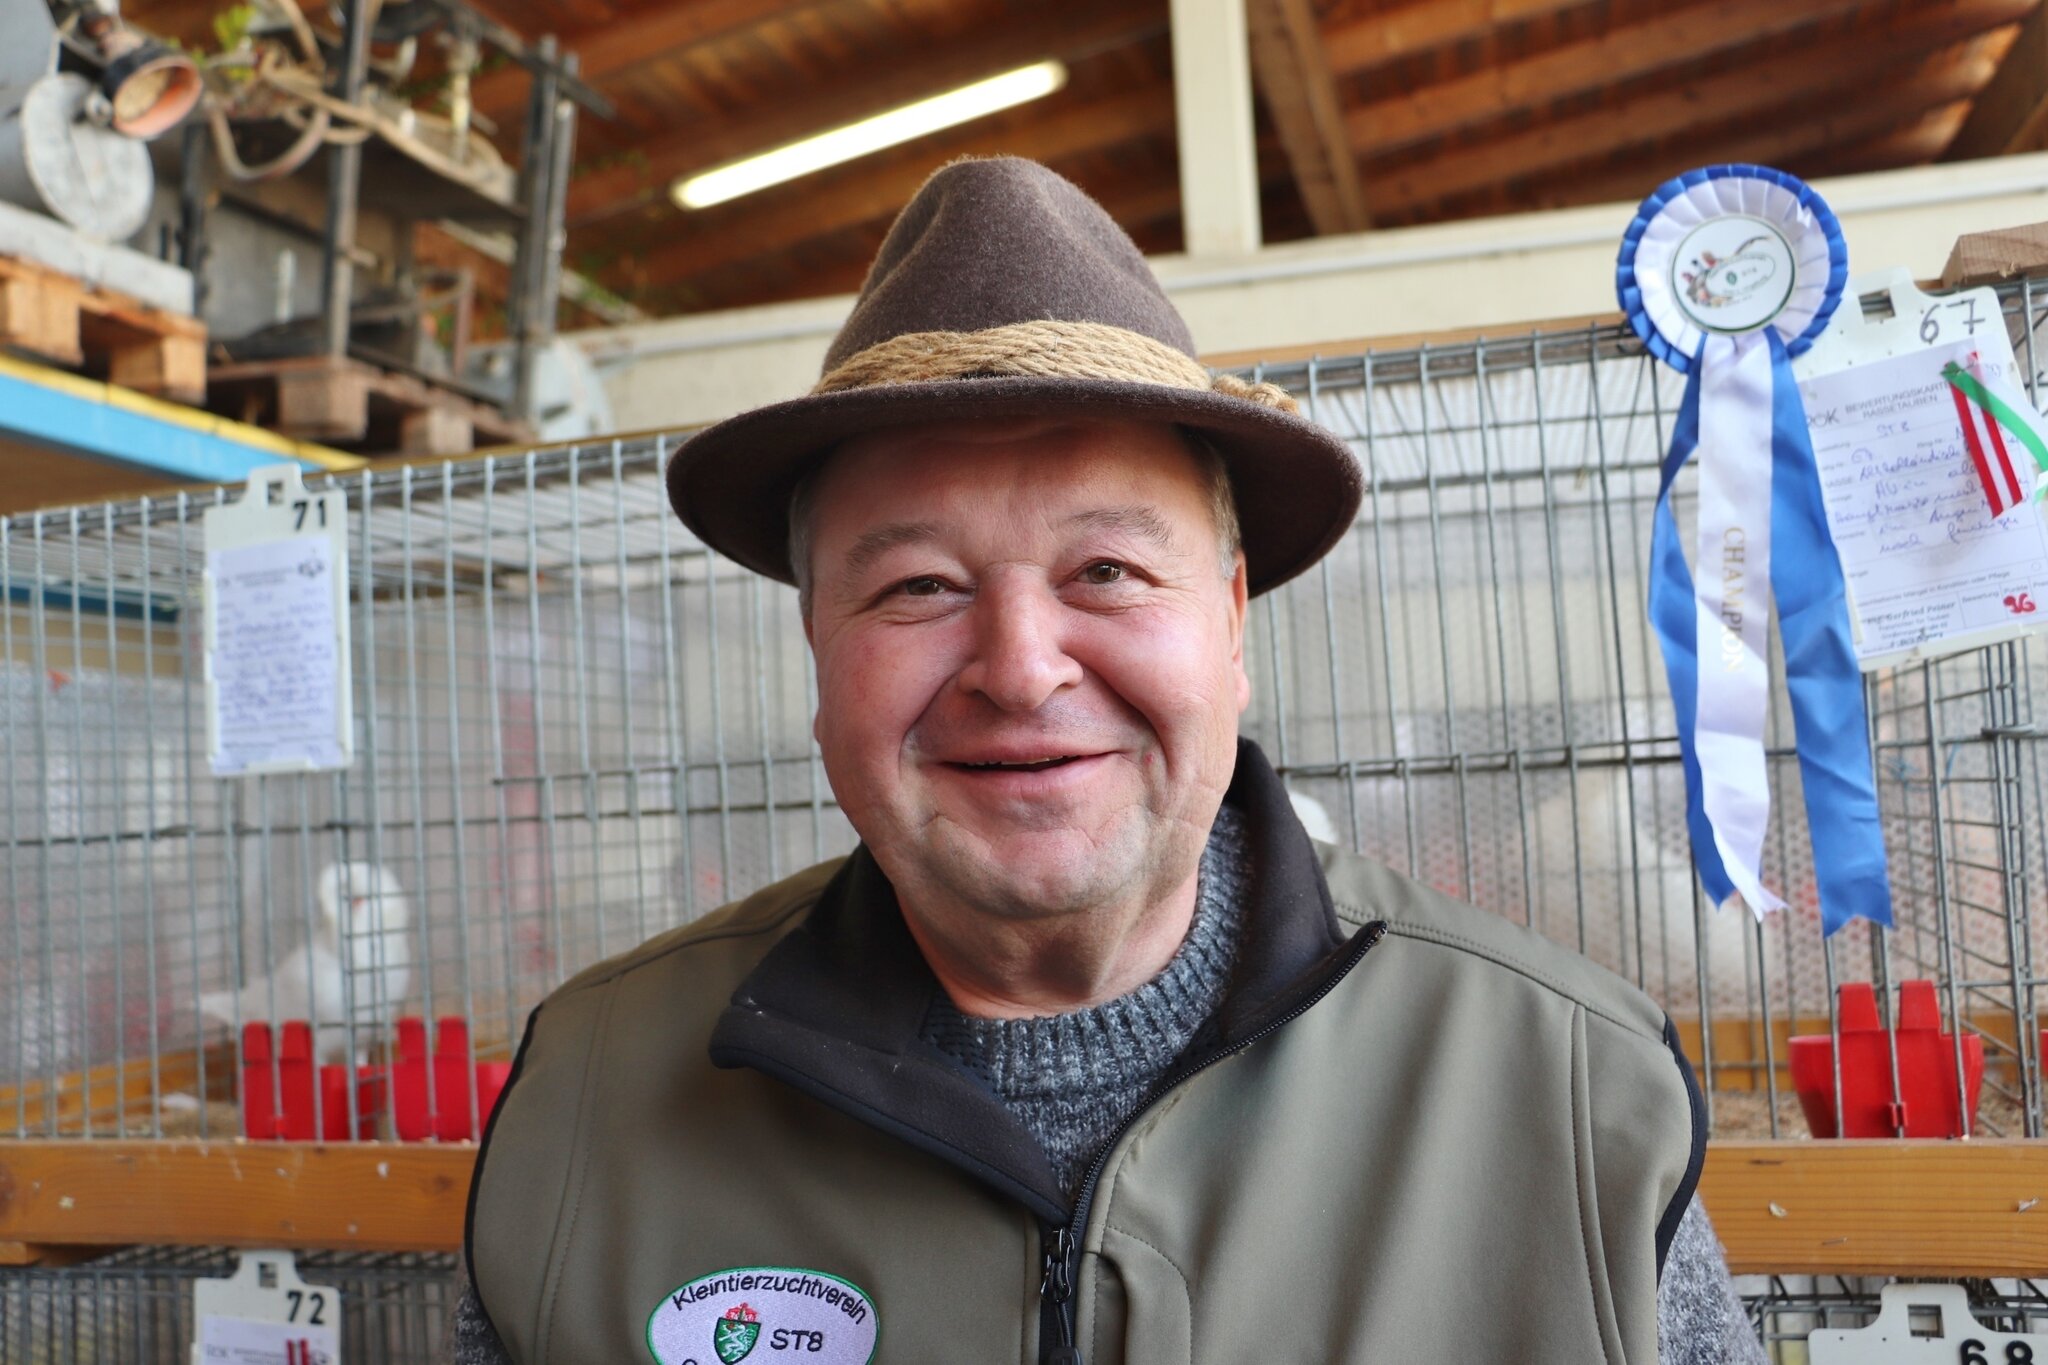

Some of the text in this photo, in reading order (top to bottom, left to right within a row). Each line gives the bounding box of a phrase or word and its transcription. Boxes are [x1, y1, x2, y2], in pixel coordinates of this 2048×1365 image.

[1919, 298, 1987, 344] 67
[293, 497, 328, 531] 71
[1721, 526, 1745, 673] CHAMPION
[2003, 592, 2036, 614] 96
[286, 1290, 326, 1325] 72
[672, 1272, 867, 1326] Kleintierzuchtverein
[770, 1327, 823, 1352] ST8
